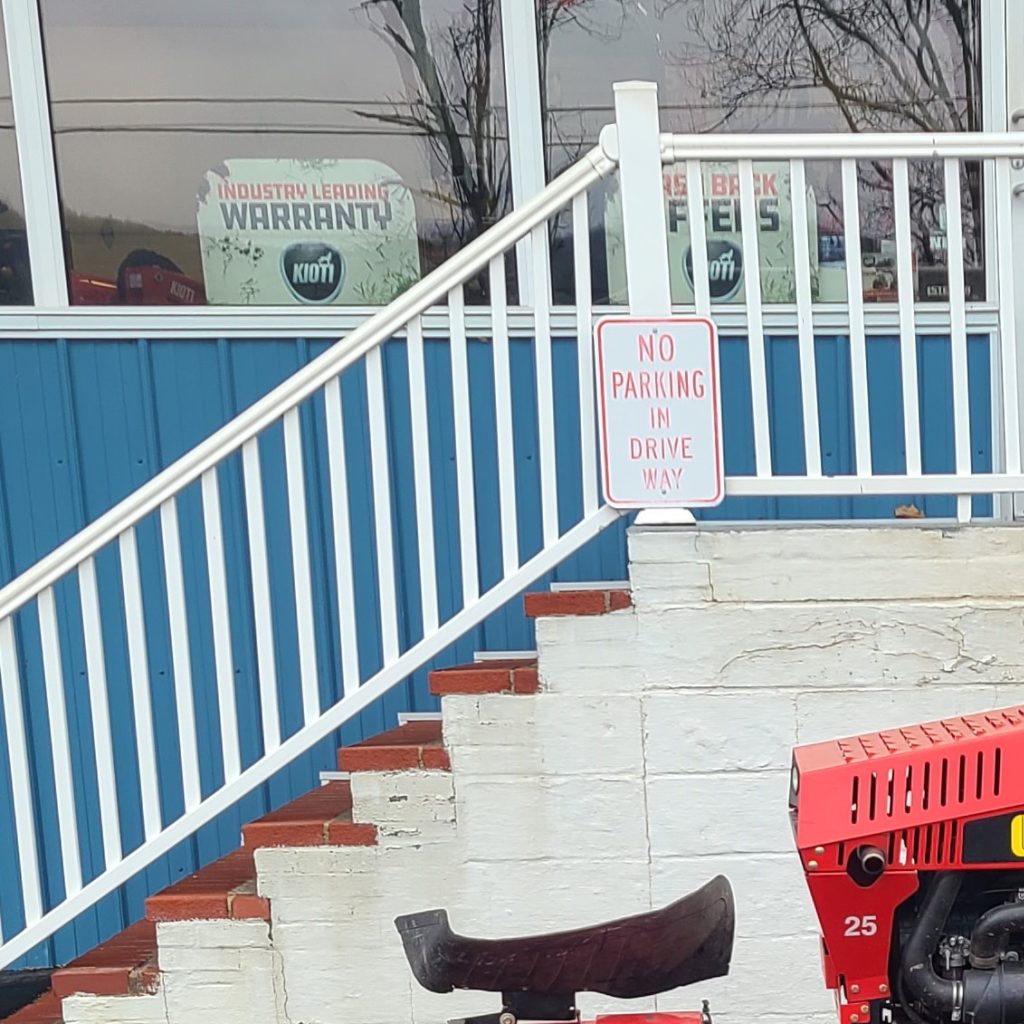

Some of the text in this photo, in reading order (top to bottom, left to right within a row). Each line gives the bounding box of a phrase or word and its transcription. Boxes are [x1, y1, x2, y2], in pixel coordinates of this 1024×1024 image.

[218, 183, 388, 200] INDUSTRY LEADING
[219, 202, 393, 231] WARRANTY
[292, 260, 335, 284] KIOTI
[170, 279, 195, 303] KIOTI
[638, 334, 675, 363] NO
[612, 370, 706, 399] PARKING
[650, 407, 670, 429] IN
[630, 436, 693, 460] DRIVE
[642, 467, 683, 489] WAY
[844, 915, 877, 936] 25
